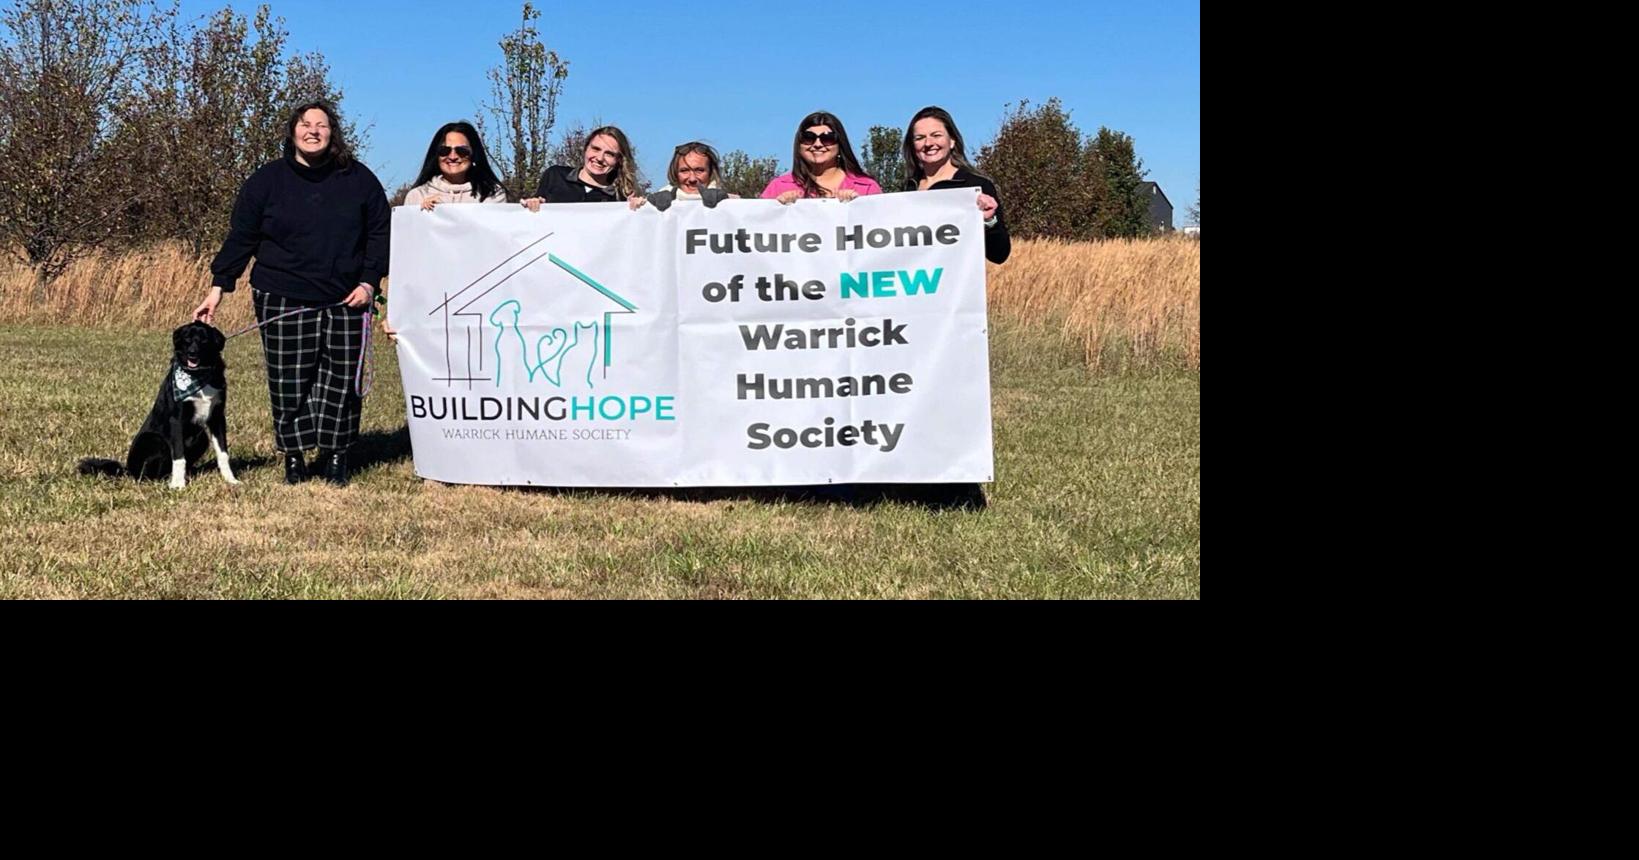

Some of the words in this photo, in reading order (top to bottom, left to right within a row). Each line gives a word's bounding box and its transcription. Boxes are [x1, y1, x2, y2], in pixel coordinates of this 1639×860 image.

[686, 228, 822, 255] Future
[835, 223, 960, 251] Home
[702, 274, 745, 303] of
[755, 273, 826, 301] the
[840, 267, 944, 299] NEW
[738, 317, 909, 351] Warrick
[736, 372, 913, 400] Humane
[442, 428, 501, 440] WARRICK
[505, 428, 568, 440] HUMANE
[572, 428, 632, 440] SOCIETY
[747, 417, 905, 452] Society
